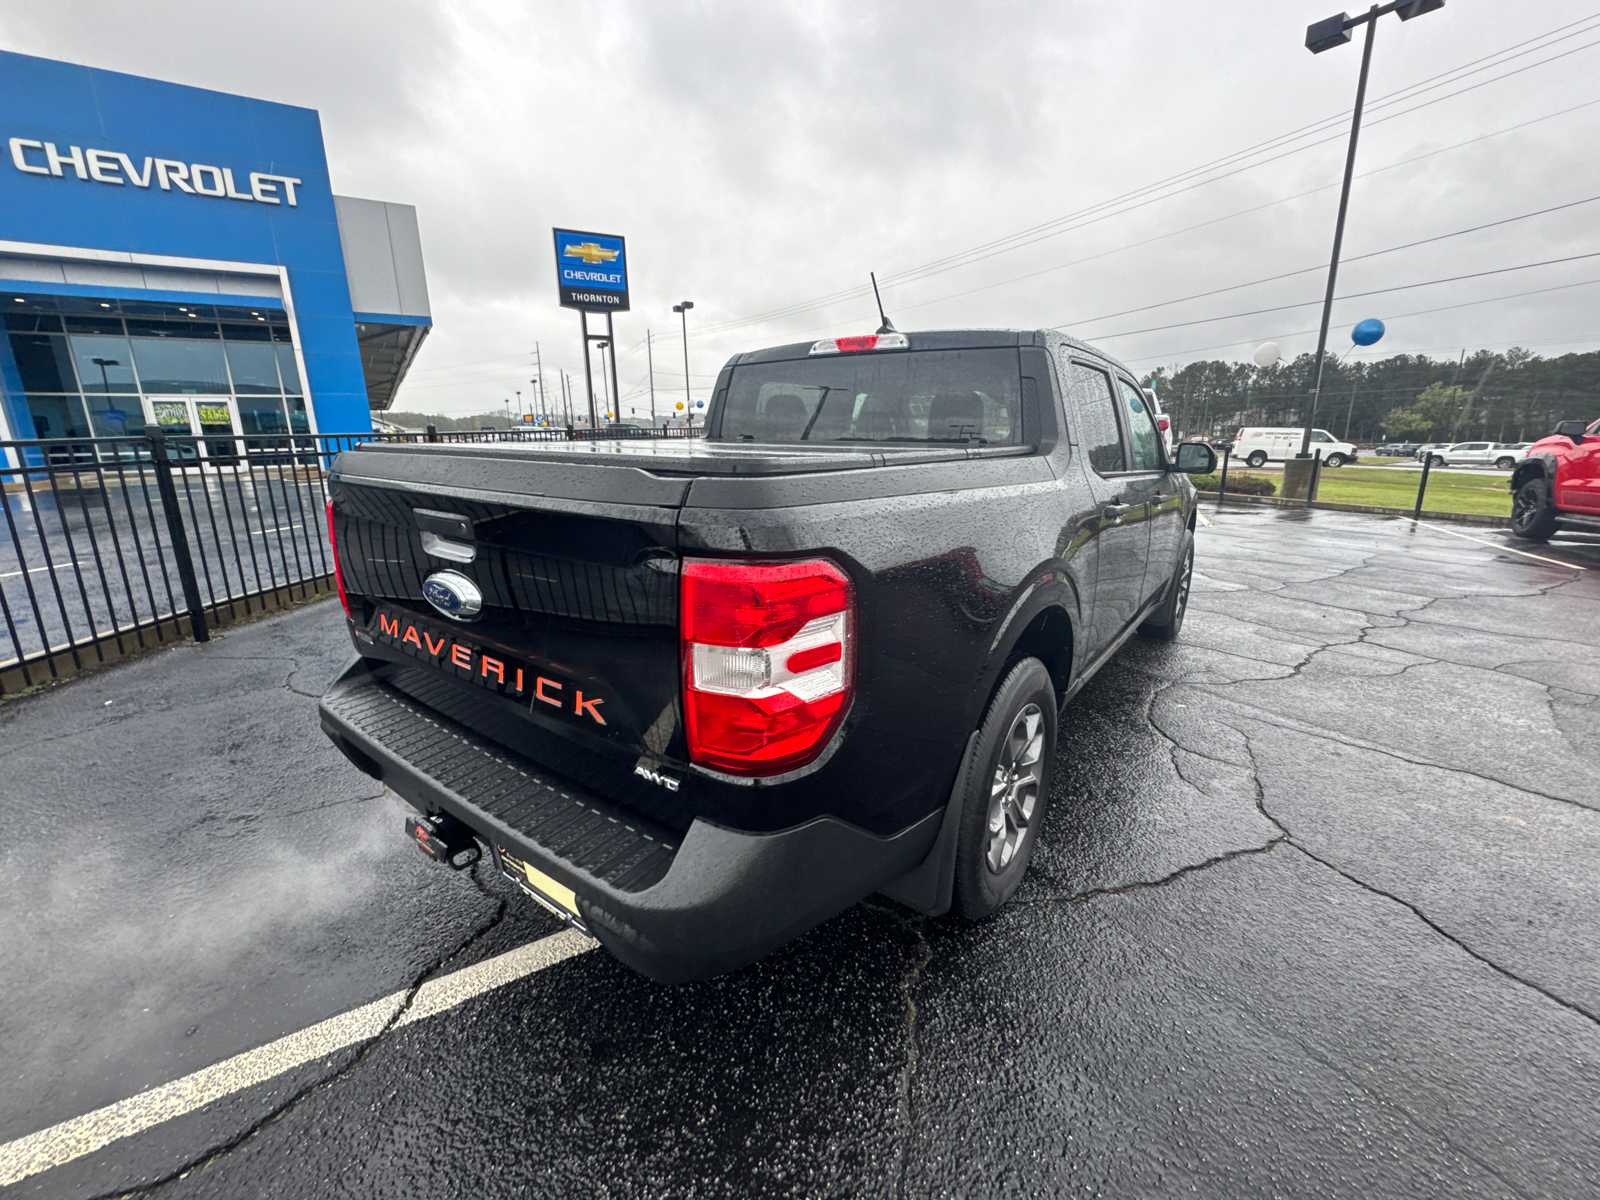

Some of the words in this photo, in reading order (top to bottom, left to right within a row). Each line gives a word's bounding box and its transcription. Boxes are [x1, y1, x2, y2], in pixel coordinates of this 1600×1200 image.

[9, 137, 301, 206] CHEVROLET
[564, 269, 621, 283] CHEVROLET
[571, 292, 619, 304] THORNTON
[380, 613, 607, 726] MAVERICK
